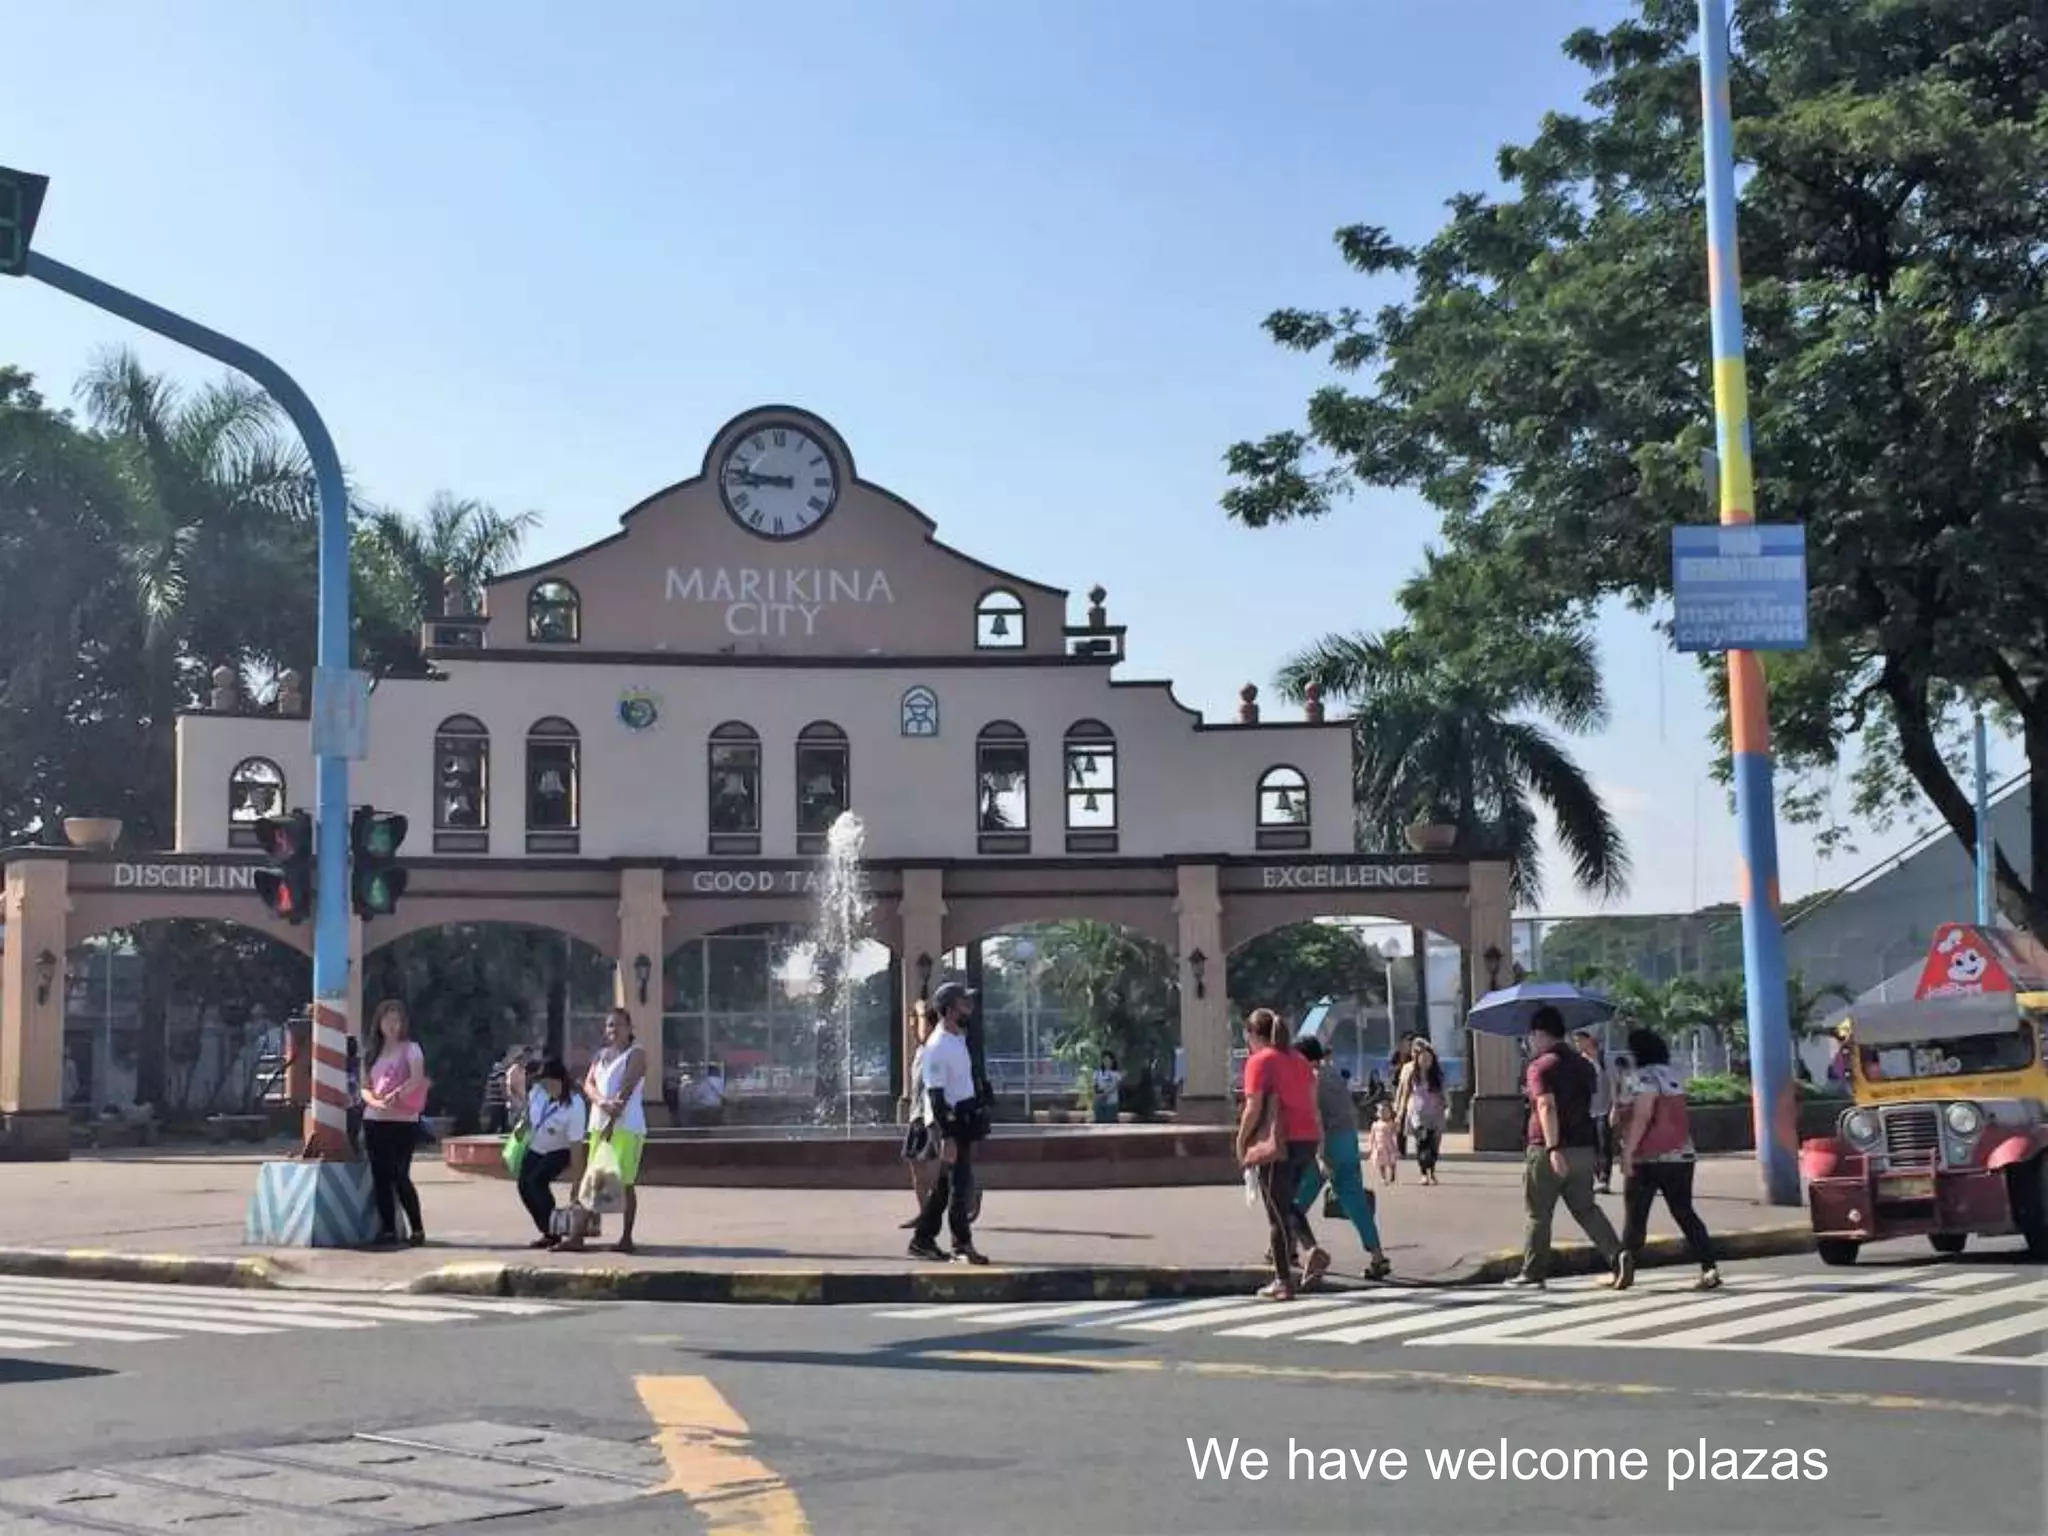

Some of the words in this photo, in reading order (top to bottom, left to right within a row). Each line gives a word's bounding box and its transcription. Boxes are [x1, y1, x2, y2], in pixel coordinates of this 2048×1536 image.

[664, 566, 896, 604] MARIKINA
[724, 602, 822, 636] CITY
[692, 870, 775, 893] GOOD
[784, 869, 873, 893] TAE
[1263, 864, 1431, 888] EXCELLENCE
